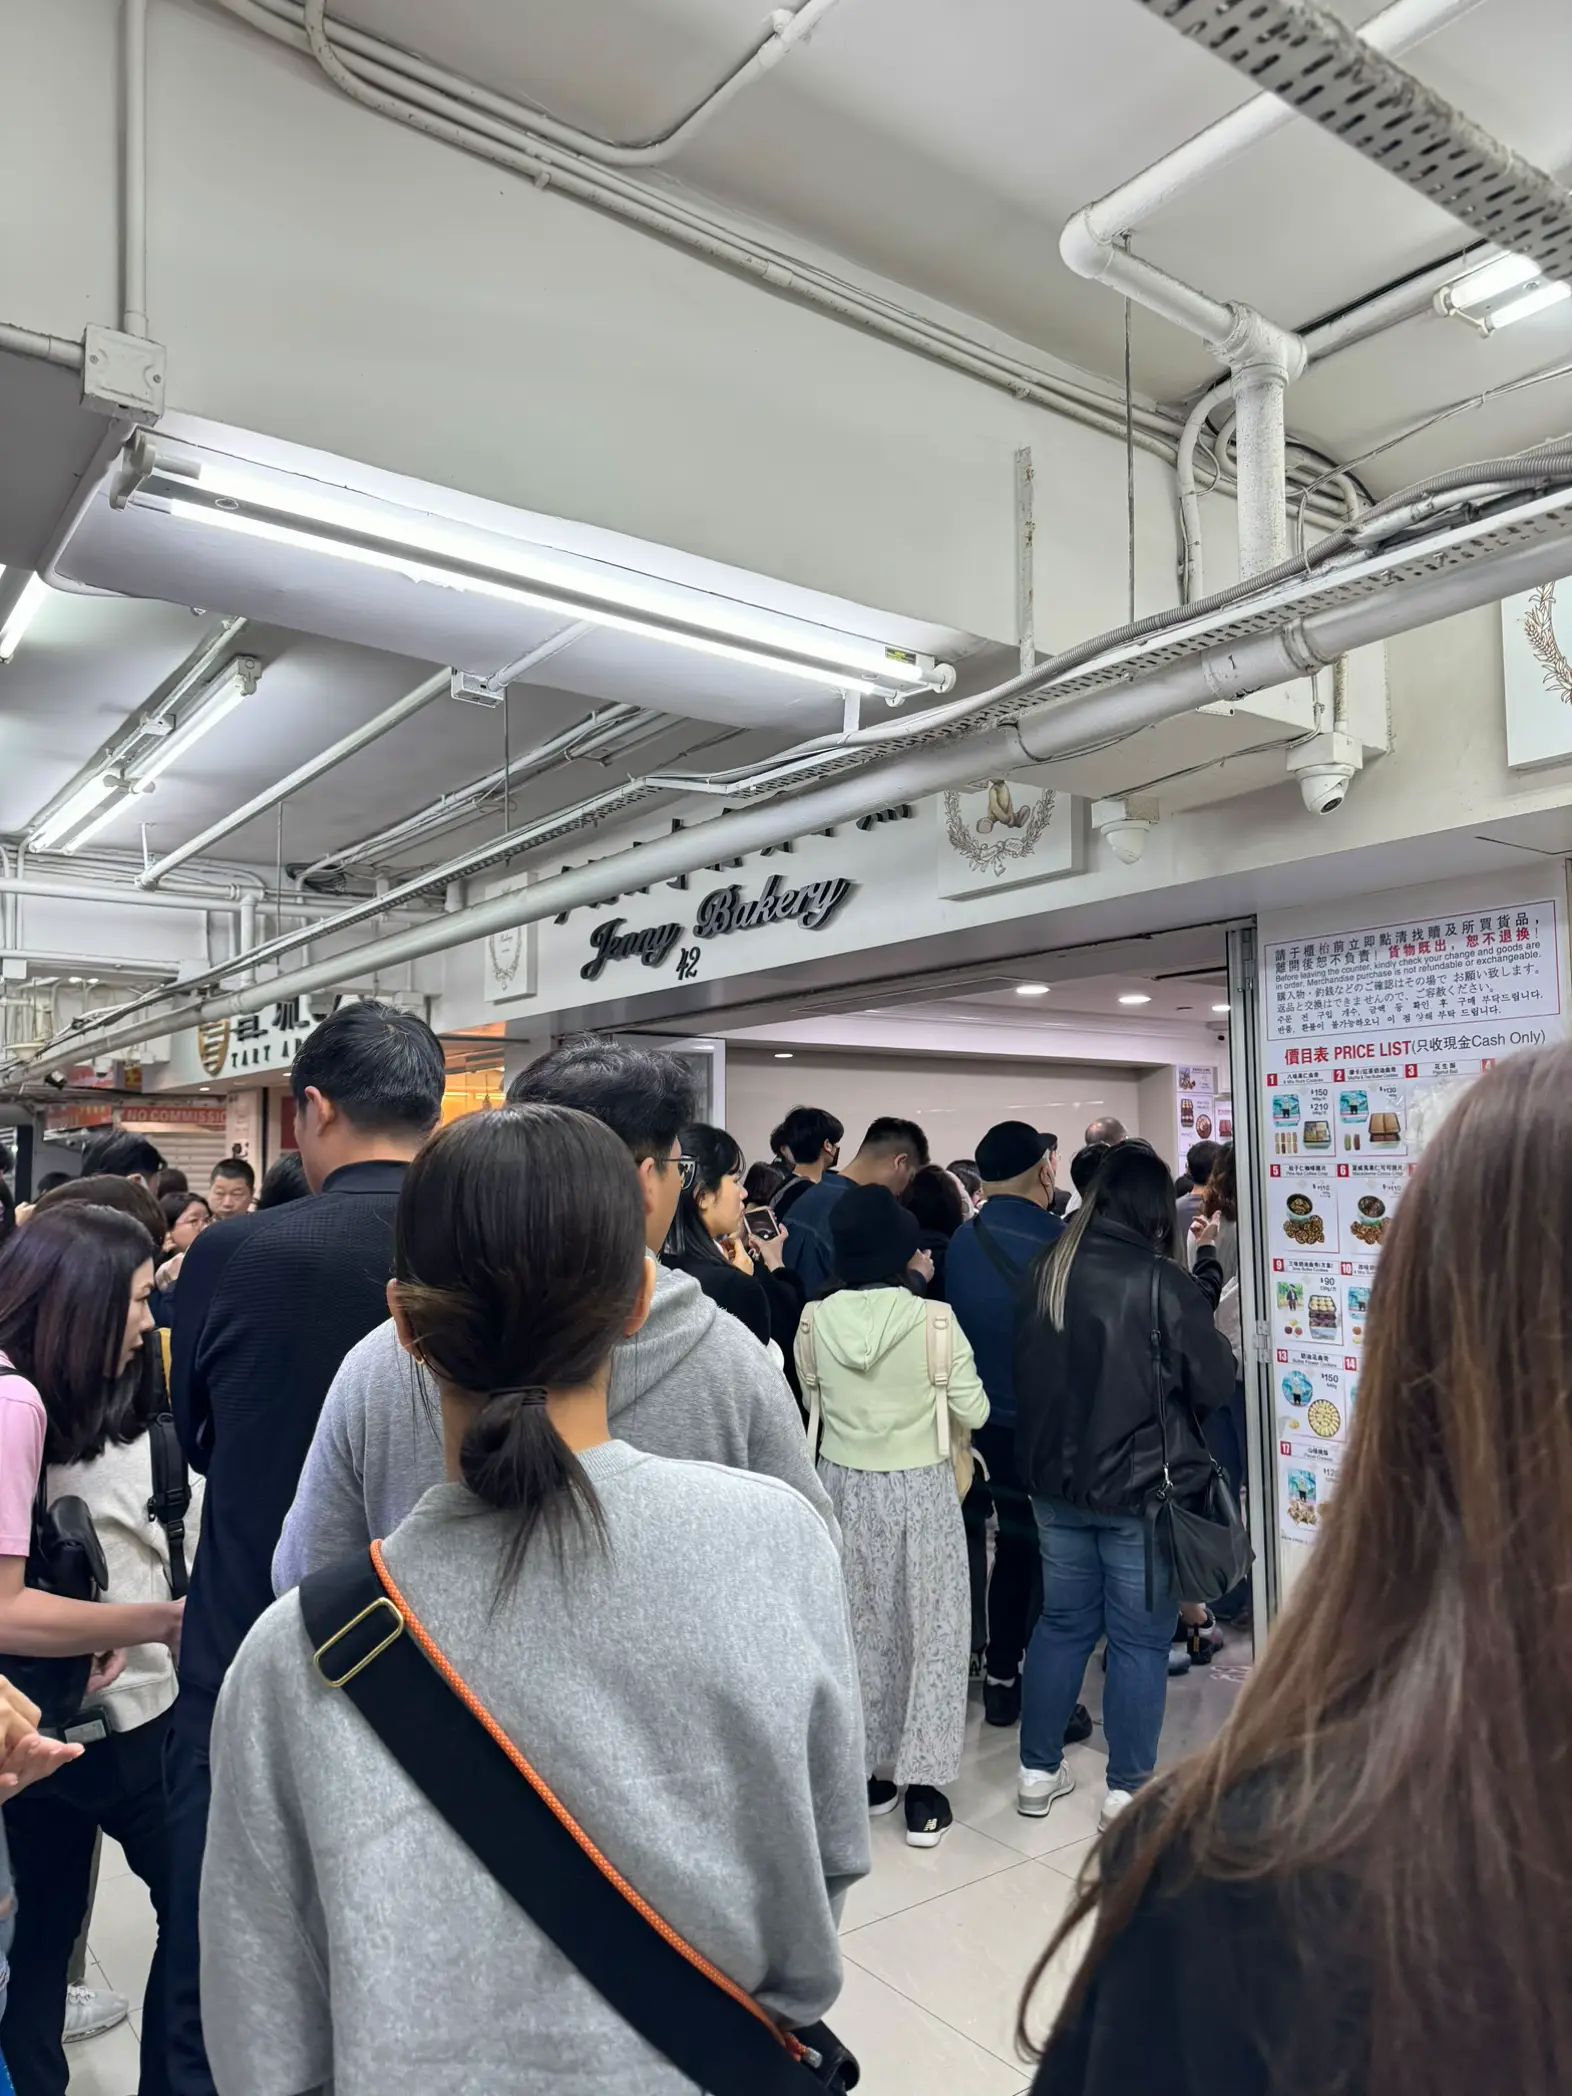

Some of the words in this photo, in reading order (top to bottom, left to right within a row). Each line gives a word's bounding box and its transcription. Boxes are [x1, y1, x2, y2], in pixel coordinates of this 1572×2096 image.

[580, 918, 684, 981] Jenny
[694, 874, 851, 939] Bakery
[676, 946, 701, 981] 42
[1276, 973, 1298, 984] Before
[1300, 970, 1326, 981] leaving
[1328, 968, 1340, 976] the
[1374, 960, 1396, 972] kindly
[1398, 956, 1423, 966] check
[1424, 955, 1442, 965] your
[1444, 950, 1475, 962] change
[1478, 948, 1494, 957] and
[1496, 944, 1523, 956] goods
[1526, 942, 1540, 951] are
[1276, 982, 1284, 990] in
[1307, 974, 1354, 988] Merchandise
[1356, 970, 1392, 983] purchase
[1394, 968, 1402, 976] is
[1404, 966, 1416, 974] not
[1418, 960, 1463, 973] refundable
[1465, 960, 1474, 968] or
[1476, 951, 1541, 966] exchangeable.
[1285, 1046, 1329, 1065] 價目表
[1334, 1044, 1375, 1060] PRICE
[1380, 1040, 1412, 1057] LIST
[1510, 1030, 1546, 1046] Only)
[232, 1044, 271, 1069] TART
[1310, 1088, 1328, 1097] $150
[1310, 1102, 1328, 1111] $210
[127, 1110, 146, 1122] NO
[150, 1111, 227, 1124] COMMISSIO
[1341, 1264, 1352, 1274] 10
[1320, 1277, 1335, 1286] $90
[1278, 1350, 1288, 1362] 13
[1345, 1358, 1356, 1370] 14
[1321, 1373, 1339, 1383] $150
